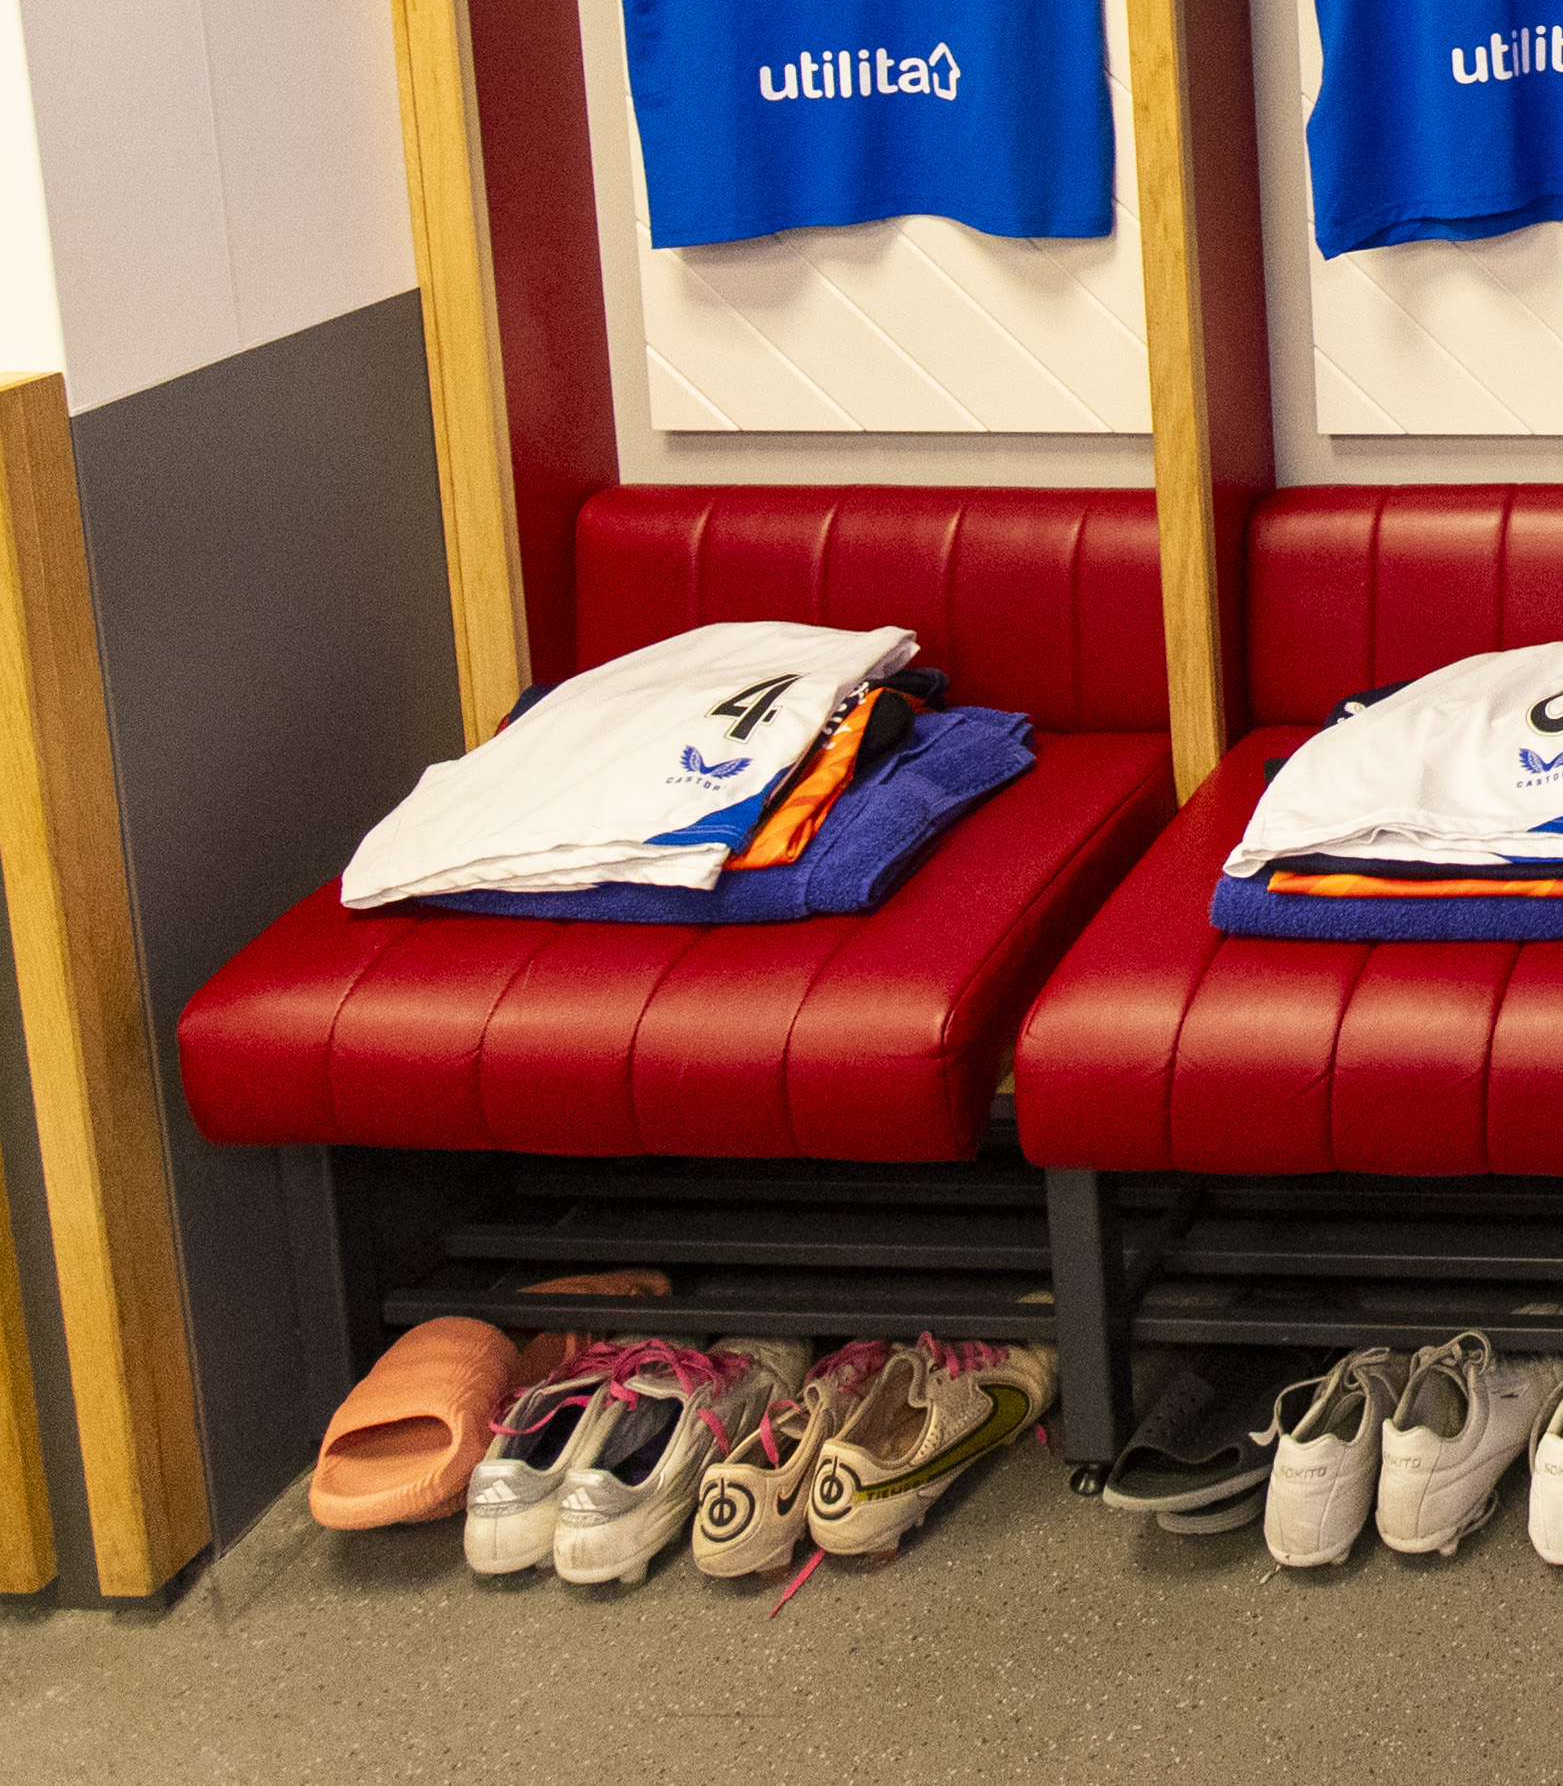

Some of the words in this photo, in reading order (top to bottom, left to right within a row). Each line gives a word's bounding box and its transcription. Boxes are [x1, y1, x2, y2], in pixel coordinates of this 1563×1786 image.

[759, 47, 932, 102] utilita
[705, 672, 805, 744] 4
[664, 775, 725, 791] CASTOR
